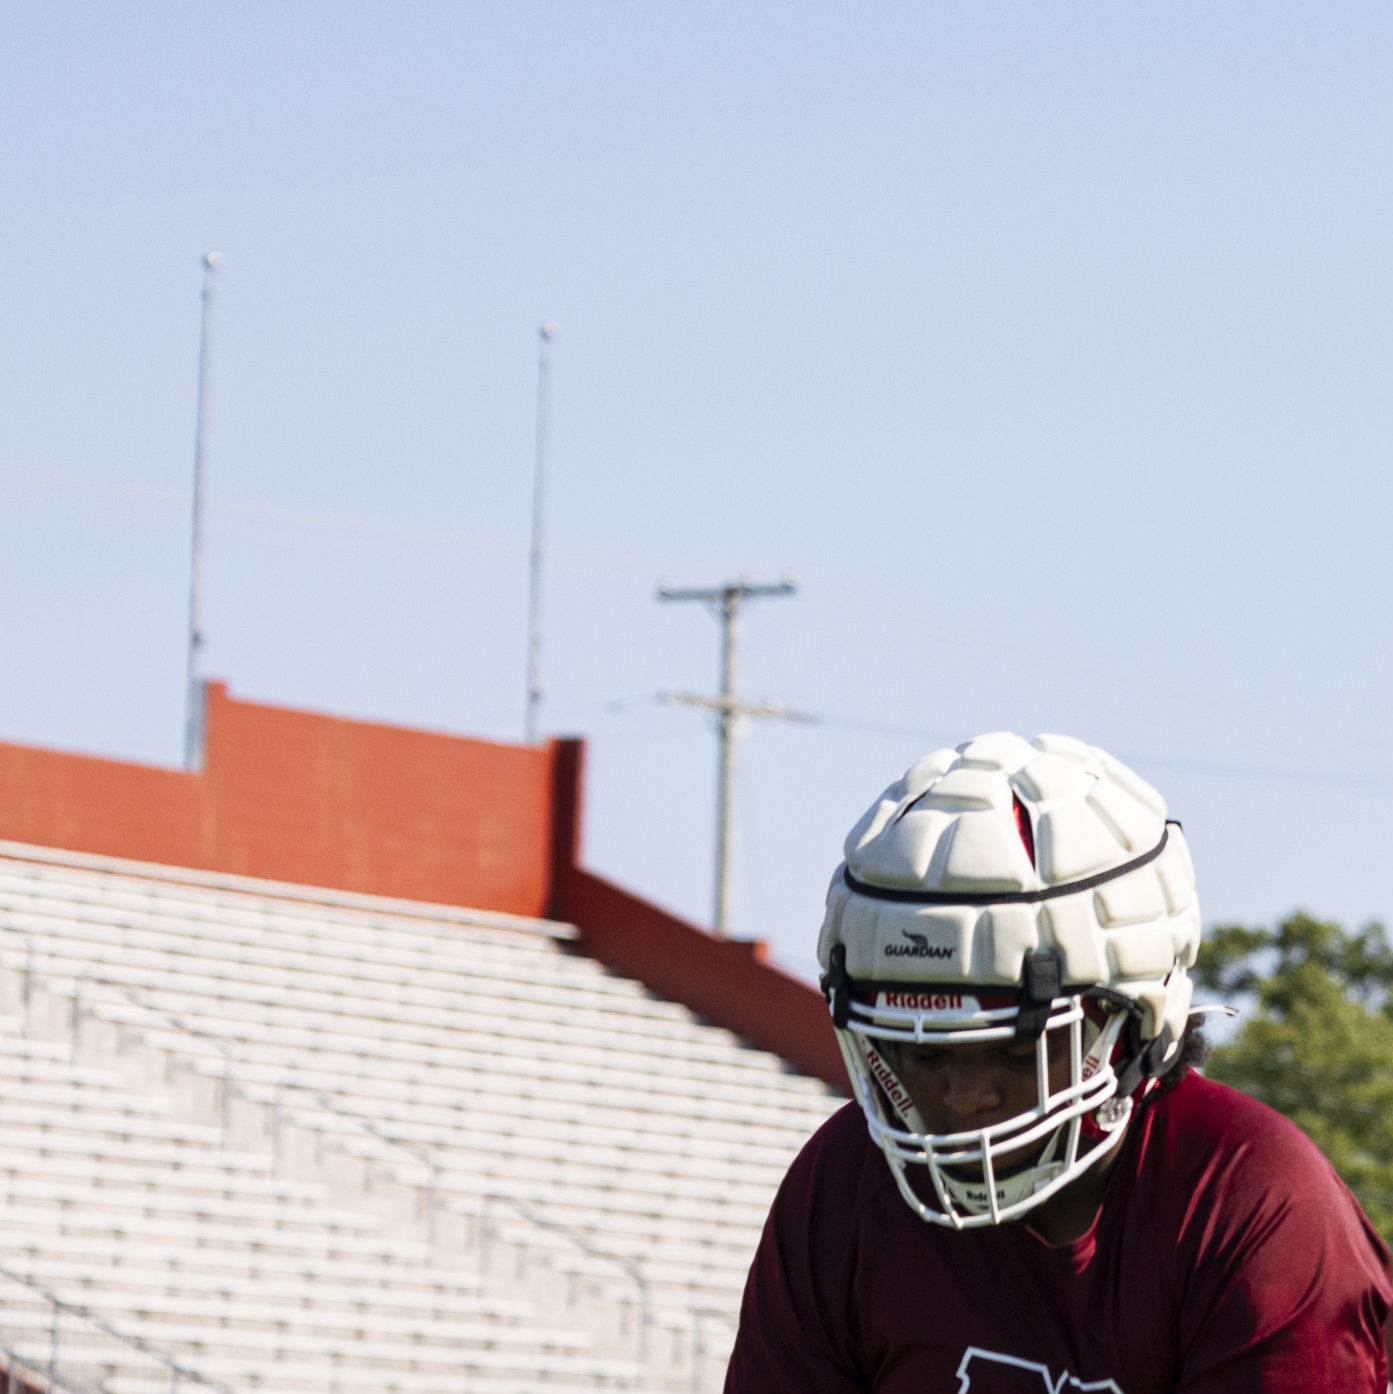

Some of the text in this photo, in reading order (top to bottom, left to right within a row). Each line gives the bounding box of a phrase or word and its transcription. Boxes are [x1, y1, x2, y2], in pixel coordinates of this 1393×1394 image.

[884, 944, 954, 959] GUARDIAN
[885, 992, 962, 1010] Riddell
[867, 1049, 913, 1113] Riddell
